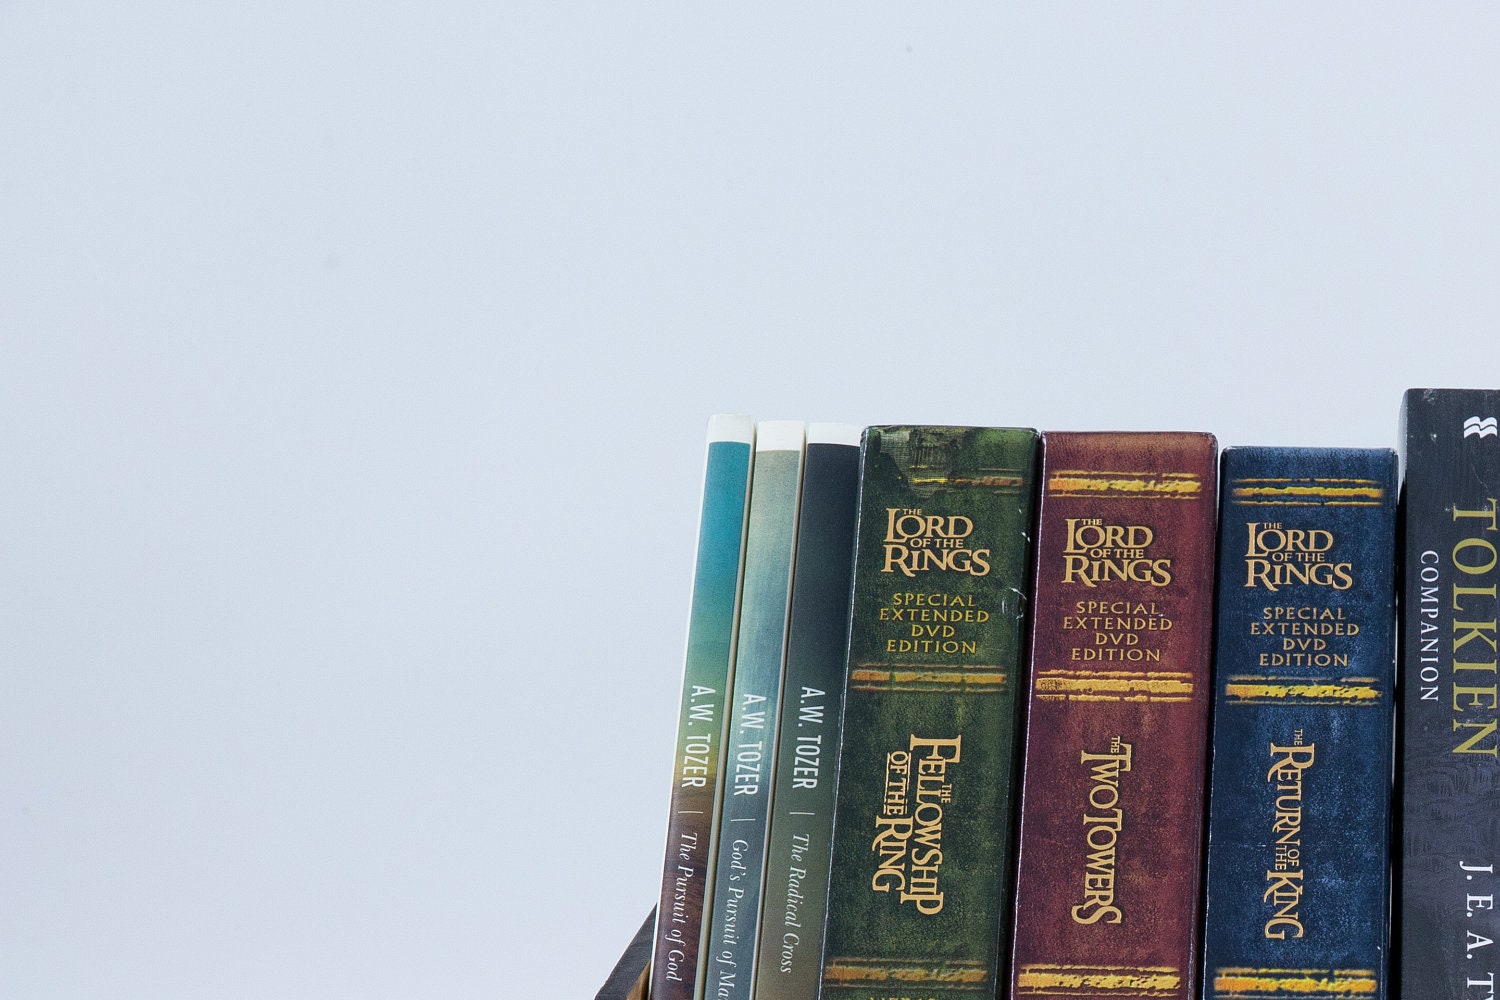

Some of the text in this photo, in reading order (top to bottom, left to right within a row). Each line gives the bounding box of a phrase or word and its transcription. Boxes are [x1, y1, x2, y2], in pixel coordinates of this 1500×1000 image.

[883, 508, 974, 543] LORD
[1063, 519, 1153, 553] LORD
[1244, 522, 1334, 557] LORD
[910, 539, 964, 548] OF THE
[1090, 549, 1144, 558] OF THE
[1272, 553, 1325, 562] OF THE
[880, 545, 991, 578] RINGS
[1061, 555, 1171, 588] RINGS
[1244, 559, 1353, 592] RINGS
[892, 593, 976, 607] SPECIAL
[1076, 601, 1160, 615] SPECIAL
[1263, 607, 1347, 620] SPECIAL
[879, 608, 990, 623] EXTENDED
[1063, 617, 1173, 630] EXTENDED
[1250, 622, 1360, 635] EXTENDED
[1420, 550, 1439, 701] COMPANION
[1452, 497, 1498, 758] TOLKIEN
[911, 624, 956, 638] DVD
[1095, 633, 1139, 645] DVD
[1283, 638, 1327, 651] DVD
[886, 640, 977, 654] EDITION
[1071, 648, 1160, 661] EDITION
[1259, 653, 1349, 667] EDITION
[740, 694, 767, 734] A.W.
[733, 742, 762, 796] TOZER
[665, 685, 716, 982] A.W. TOZER The Pursuit of God
[779, 686, 825, 974] A.W. TOZER The Radical Cross
[871, 750, 914, 893] OF THE RING
[900, 733, 962, 915] THE FELLOWSHIP
[1071, 736, 1132, 925] THE TWO TOWERS
[1263, 728, 1315, 940] THE RETURN OF THE KING
[730, 839, 748, 881] God's
[1459, 861, 1493, 881] J.
[725, 885, 744, 945] Pursuit
[1466, 892, 1493, 918] E.
[716, 948, 735, 968] of
[1466, 930, 1494, 960] A.
